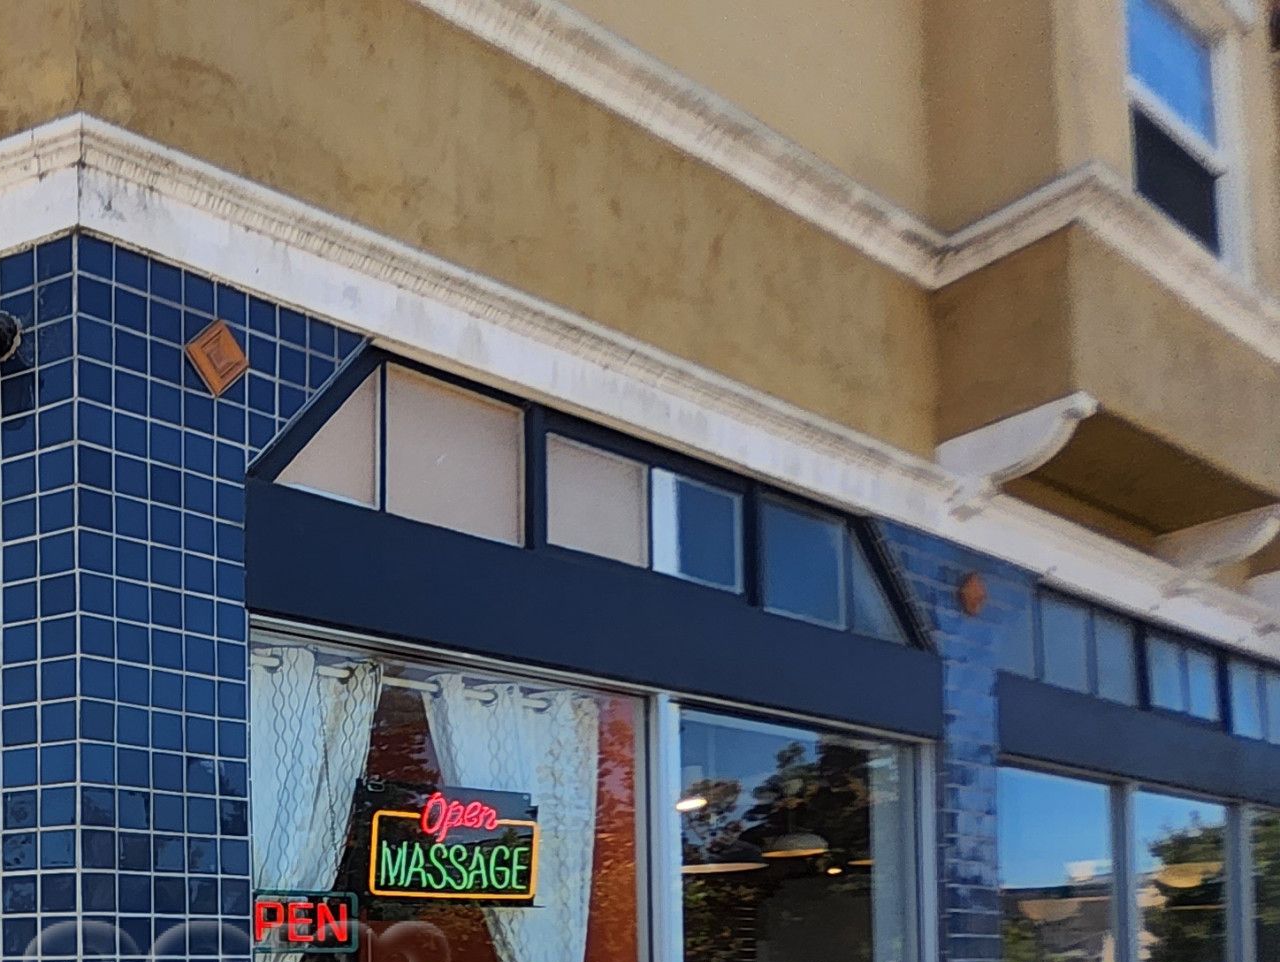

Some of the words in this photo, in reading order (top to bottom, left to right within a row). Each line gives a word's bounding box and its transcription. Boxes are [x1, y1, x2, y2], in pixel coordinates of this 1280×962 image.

[422, 791, 499, 843] Open
[379, 839, 529, 890] MASSAGE
[254, 901, 348, 942] PEN
